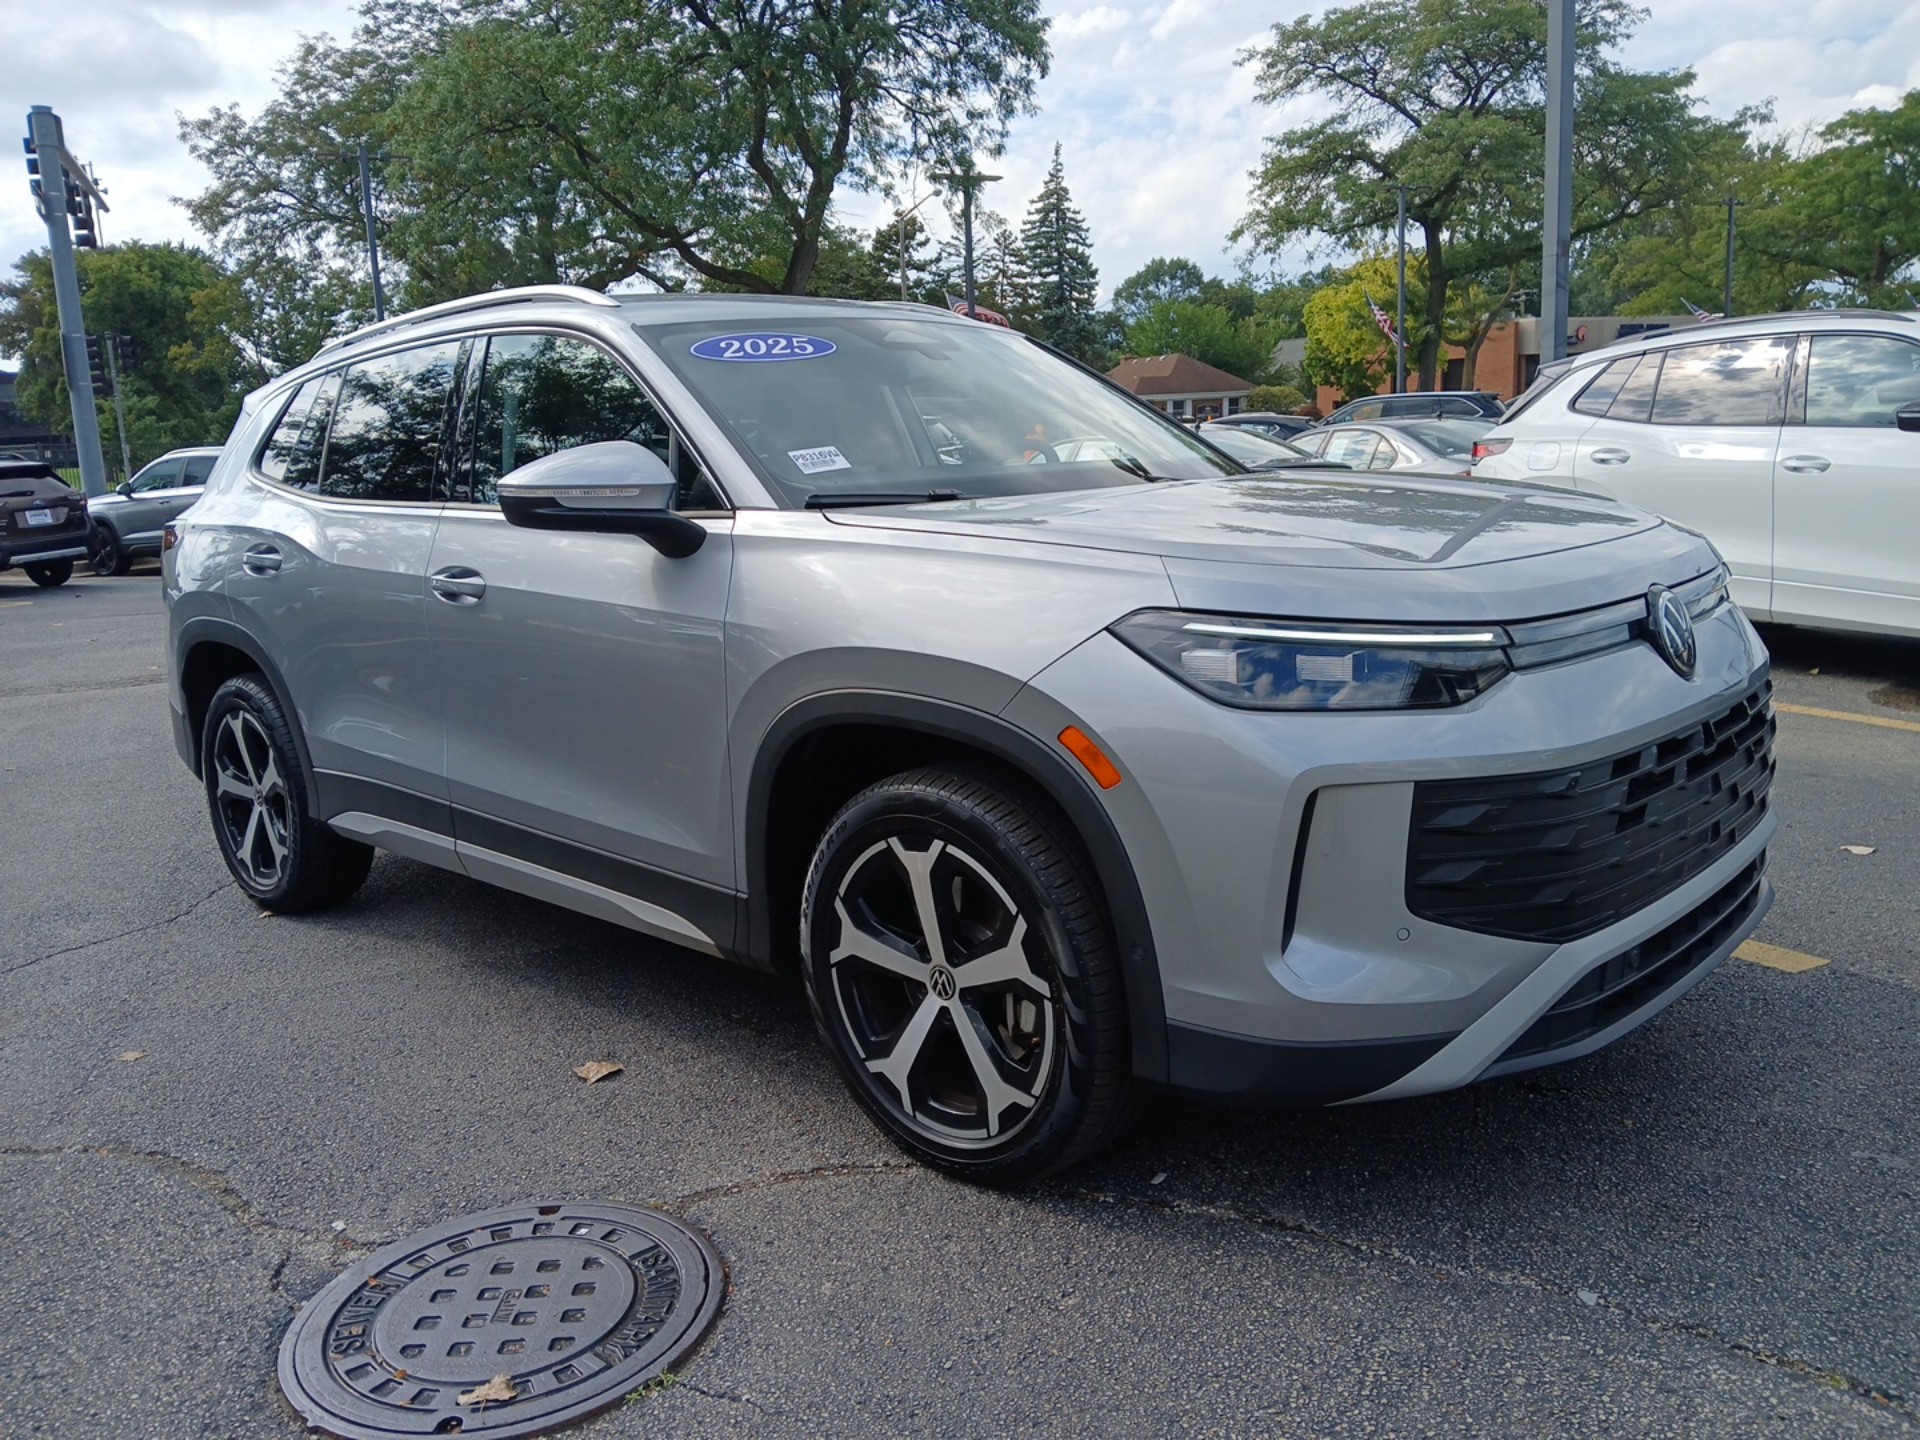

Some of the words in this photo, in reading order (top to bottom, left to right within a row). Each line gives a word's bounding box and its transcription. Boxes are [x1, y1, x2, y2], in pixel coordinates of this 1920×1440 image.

[719, 337, 815, 358] 2025
[826, 819, 848, 851] R19
[330, 1281, 404, 1355] SEWER
[602, 1250, 678, 1366] SANITARY
